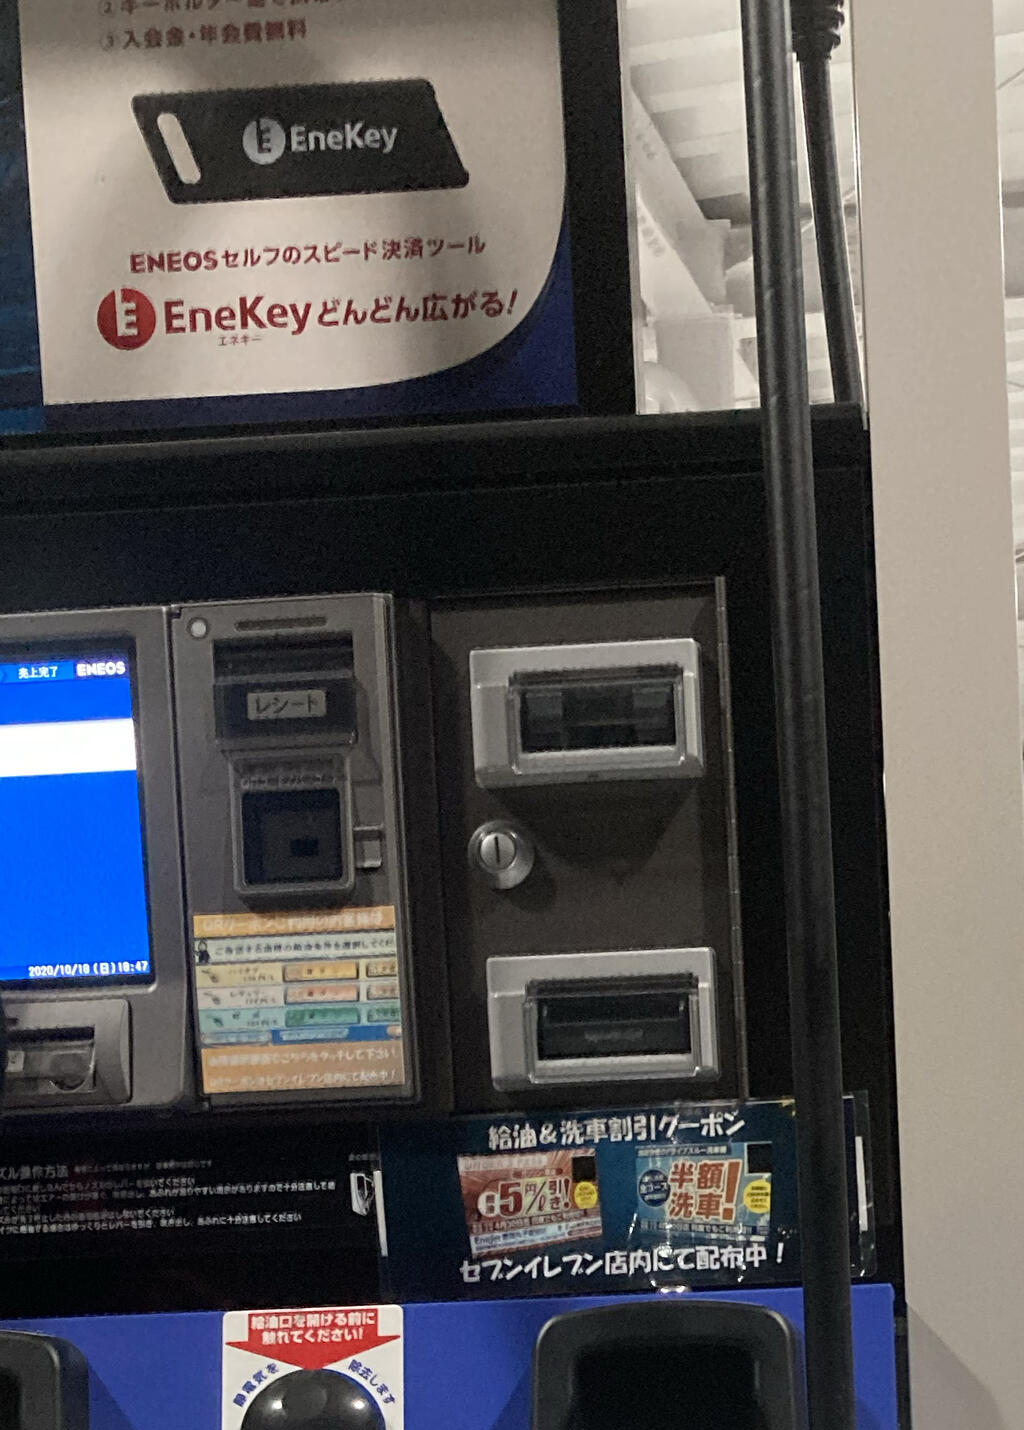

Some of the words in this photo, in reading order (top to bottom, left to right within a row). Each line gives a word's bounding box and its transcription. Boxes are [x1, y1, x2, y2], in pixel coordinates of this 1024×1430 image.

[291, 121, 398, 155] EneKey
[76, 661, 126, 677] ENEOS
[255, 694, 318, 714] レシート
[251, 1311, 376, 1330] 給油口を開ける前に
[262, 1329, 363, 1345] 触れてください!
[347, 1359, 396, 1405] 除去します
